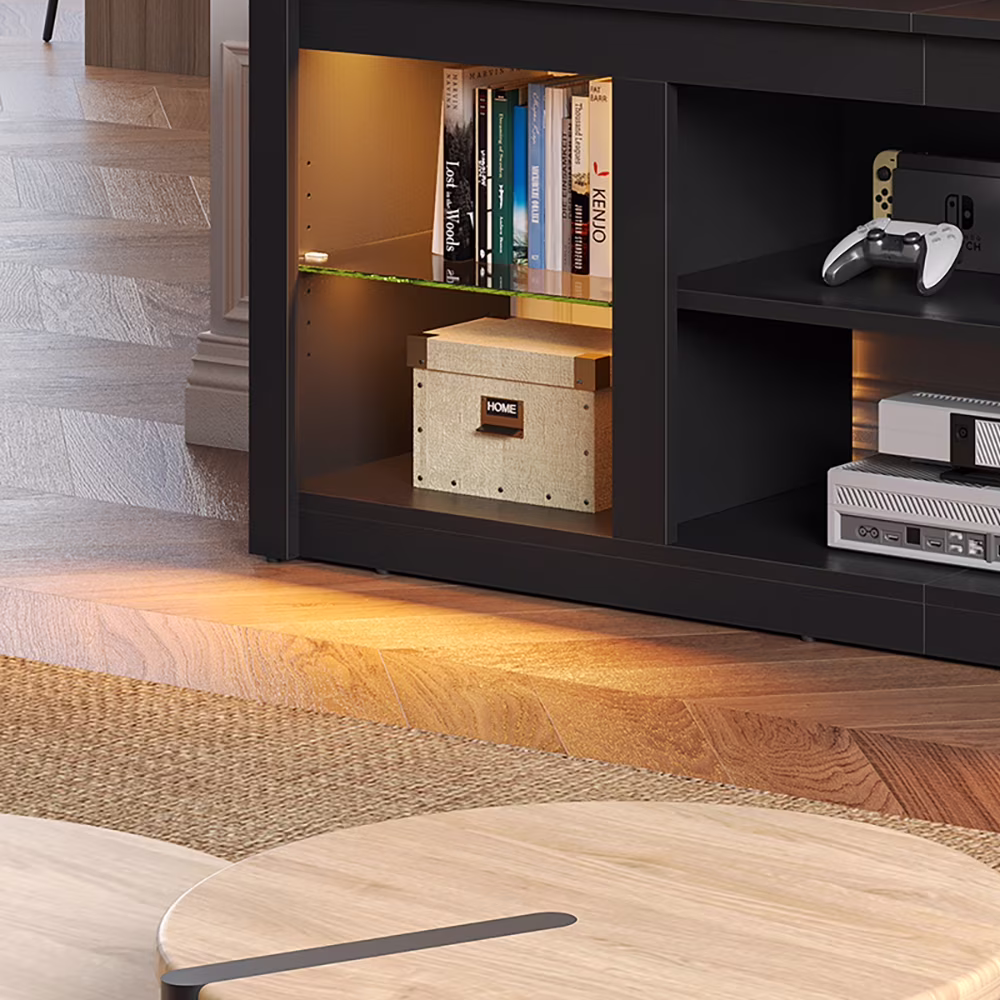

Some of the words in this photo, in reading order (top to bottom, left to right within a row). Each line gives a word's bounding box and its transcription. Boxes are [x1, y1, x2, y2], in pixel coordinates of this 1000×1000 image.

[574, 103, 583, 136] Thousand
[445, 161, 460, 188] Lost
[445, 208, 460, 252] Woods
[592, 188, 606, 243] KENJO
[487, 401, 517, 415] HOME
